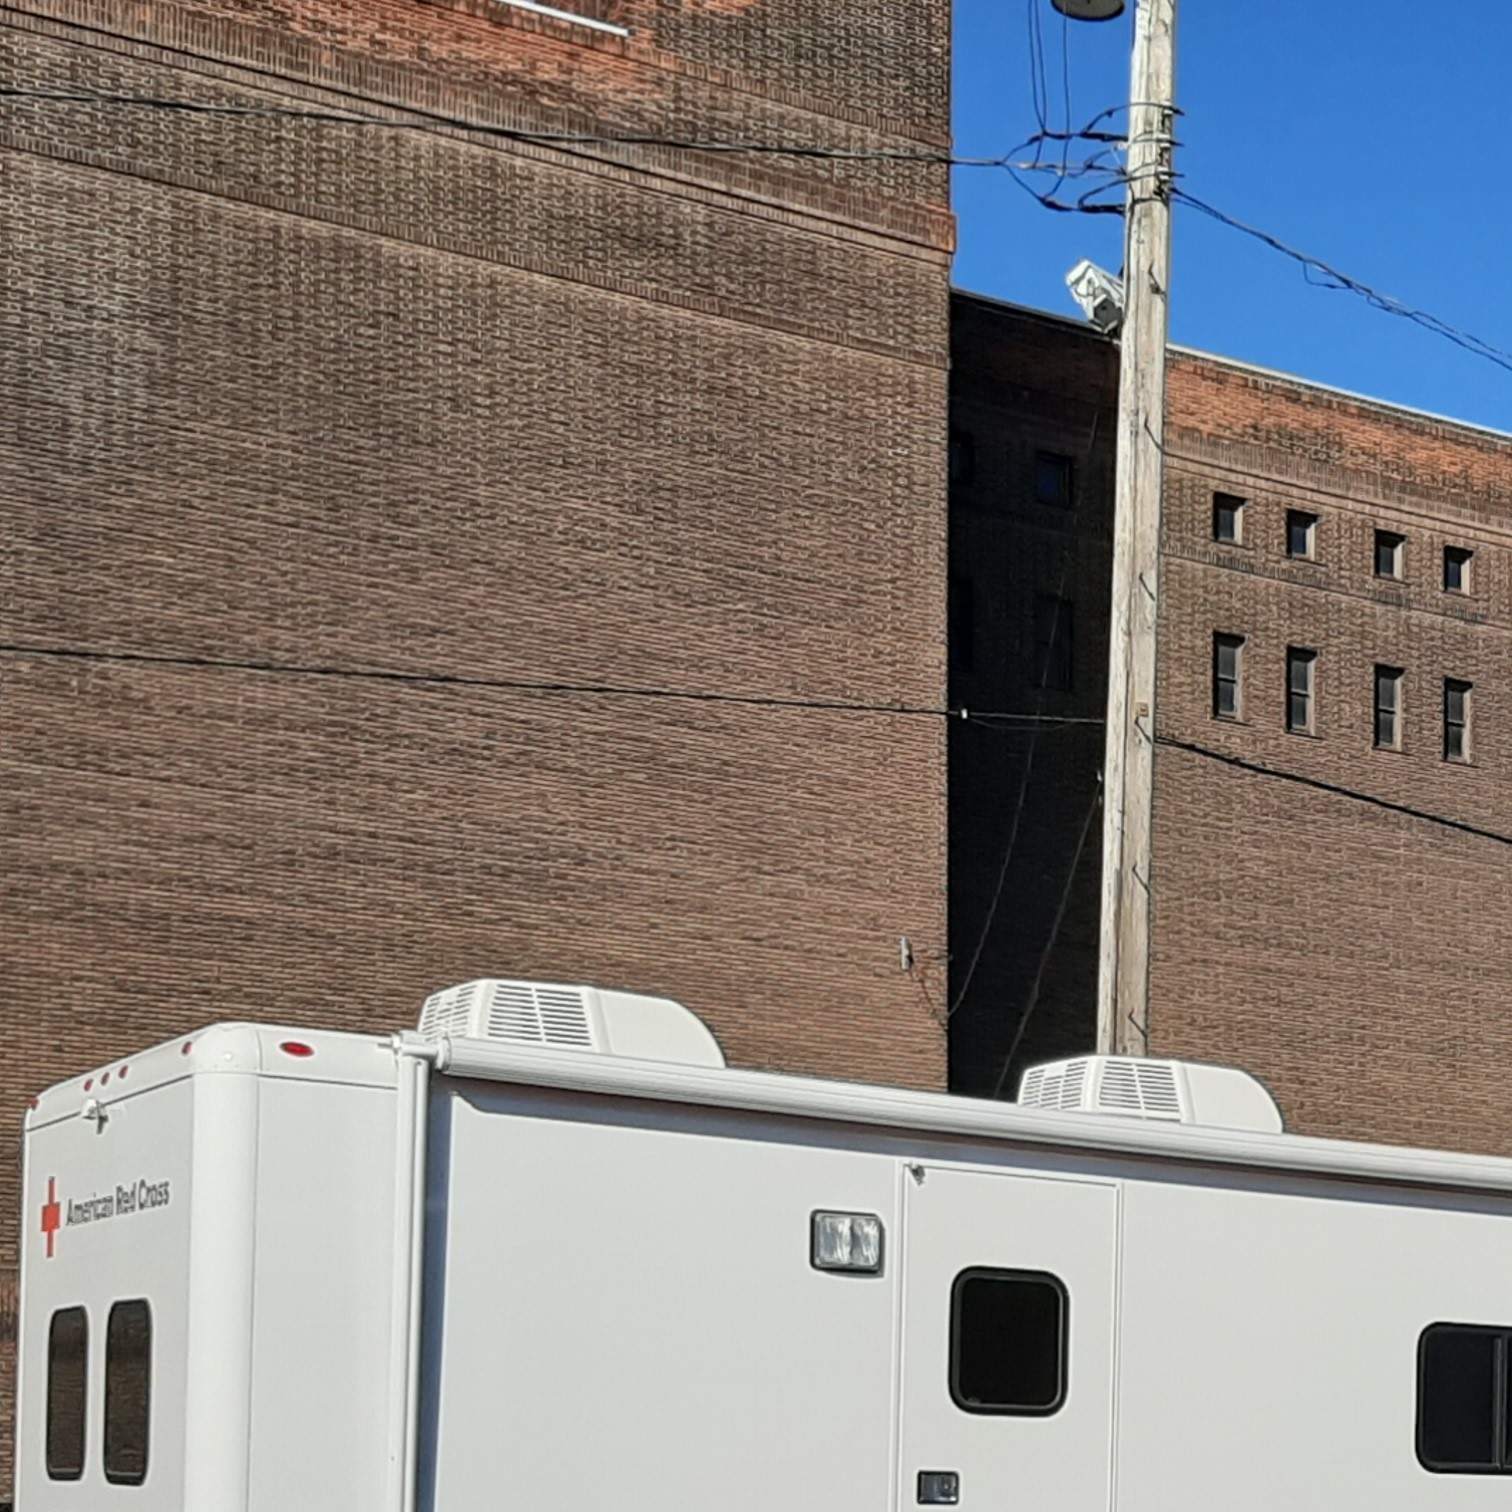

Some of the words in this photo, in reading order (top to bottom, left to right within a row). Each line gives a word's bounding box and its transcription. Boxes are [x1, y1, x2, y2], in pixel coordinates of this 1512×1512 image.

[66, 1192, 114, 1226] American
[116, 1182, 137, 1215] Red
[138, 1179, 170, 1211] Cross
